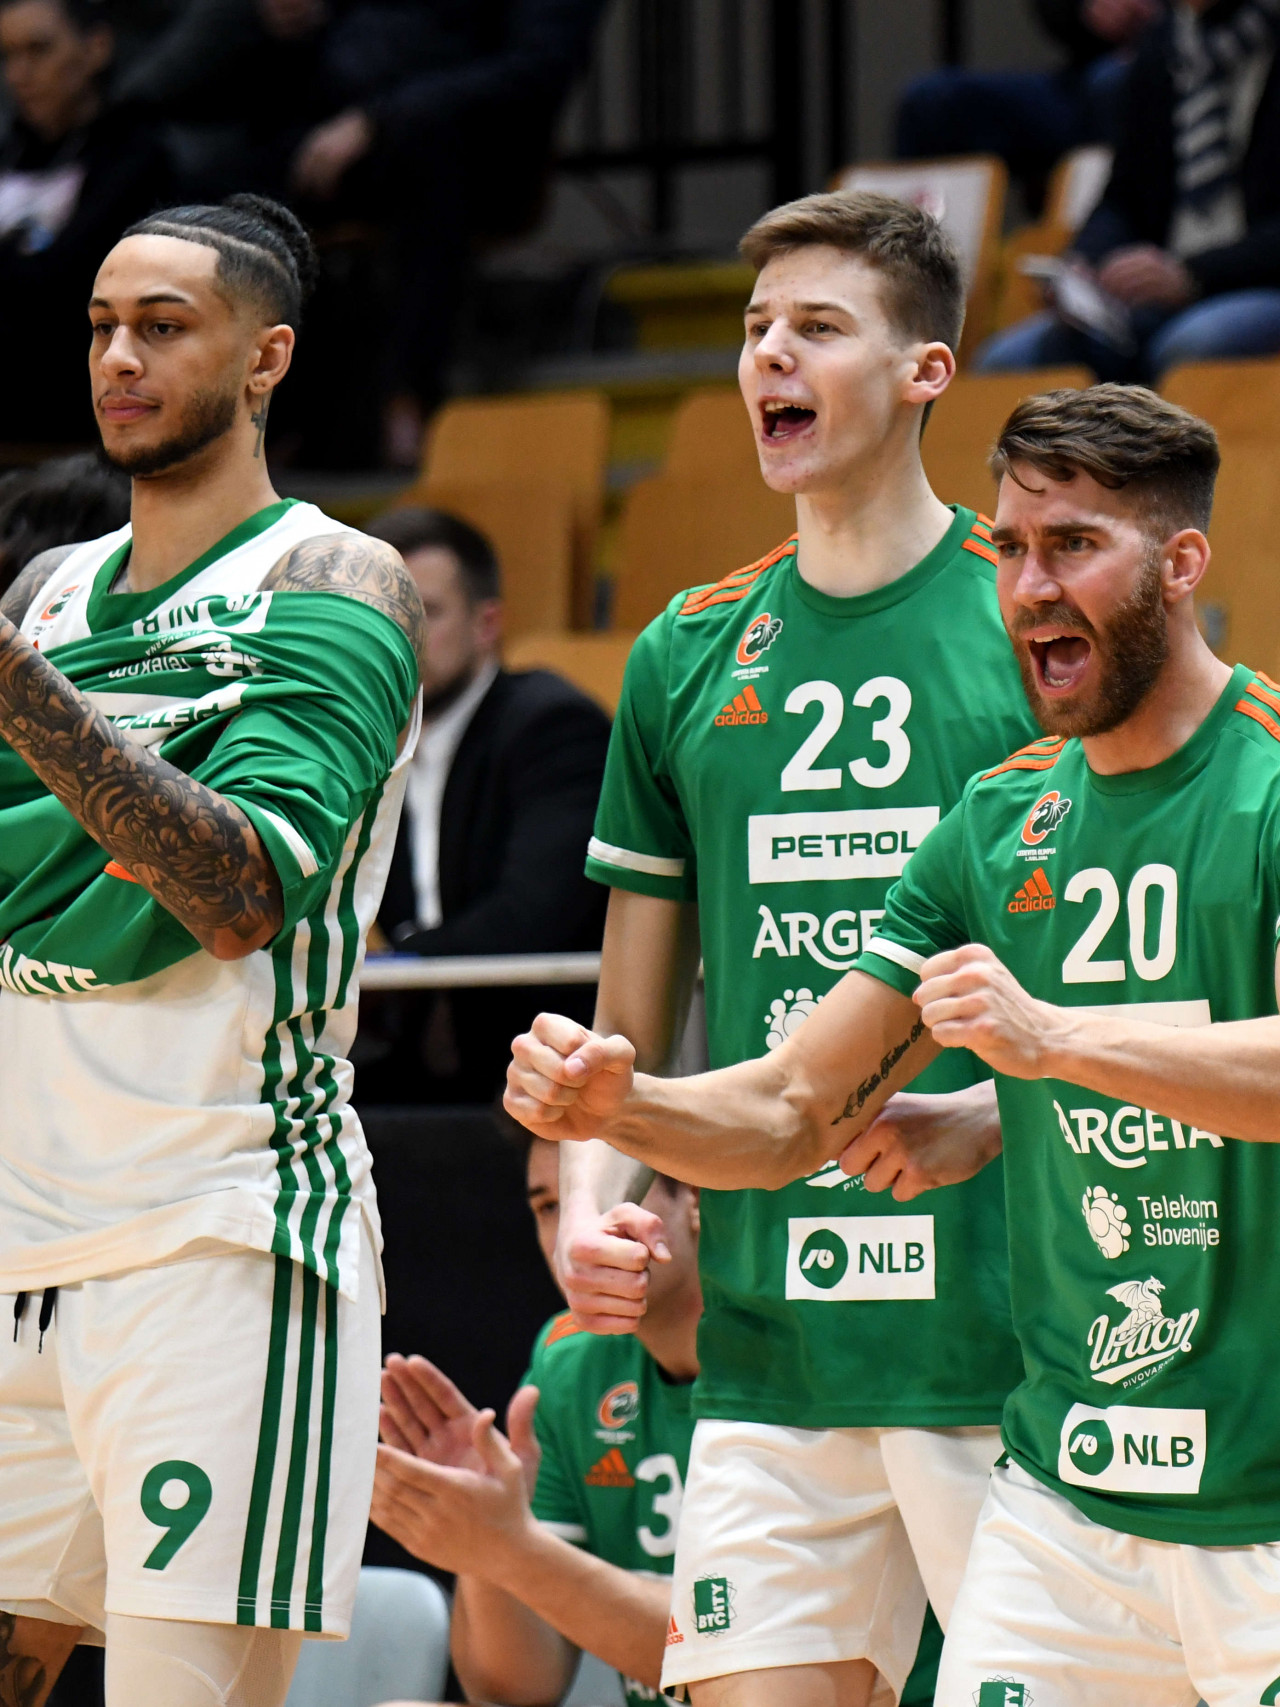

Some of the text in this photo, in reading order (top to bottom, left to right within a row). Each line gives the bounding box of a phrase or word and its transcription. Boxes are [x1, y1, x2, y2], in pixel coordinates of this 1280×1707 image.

[714, 710, 768, 727] adidas
[780, 675, 913, 792] 23
[772, 830, 919, 860] PETROL
[1061, 863, 1178, 984] 20
[1137, 1195, 1218, 1219] Telekom
[1143, 1222, 1220, 1252] Slovenije
[859, 1242, 925, 1274] NLB
[1087, 1308, 1200, 1371] Union
[1123, 1433, 1195, 1468] NLB
[140, 1459, 213, 1571] 9
[698, 1612, 727, 1629] BTC
